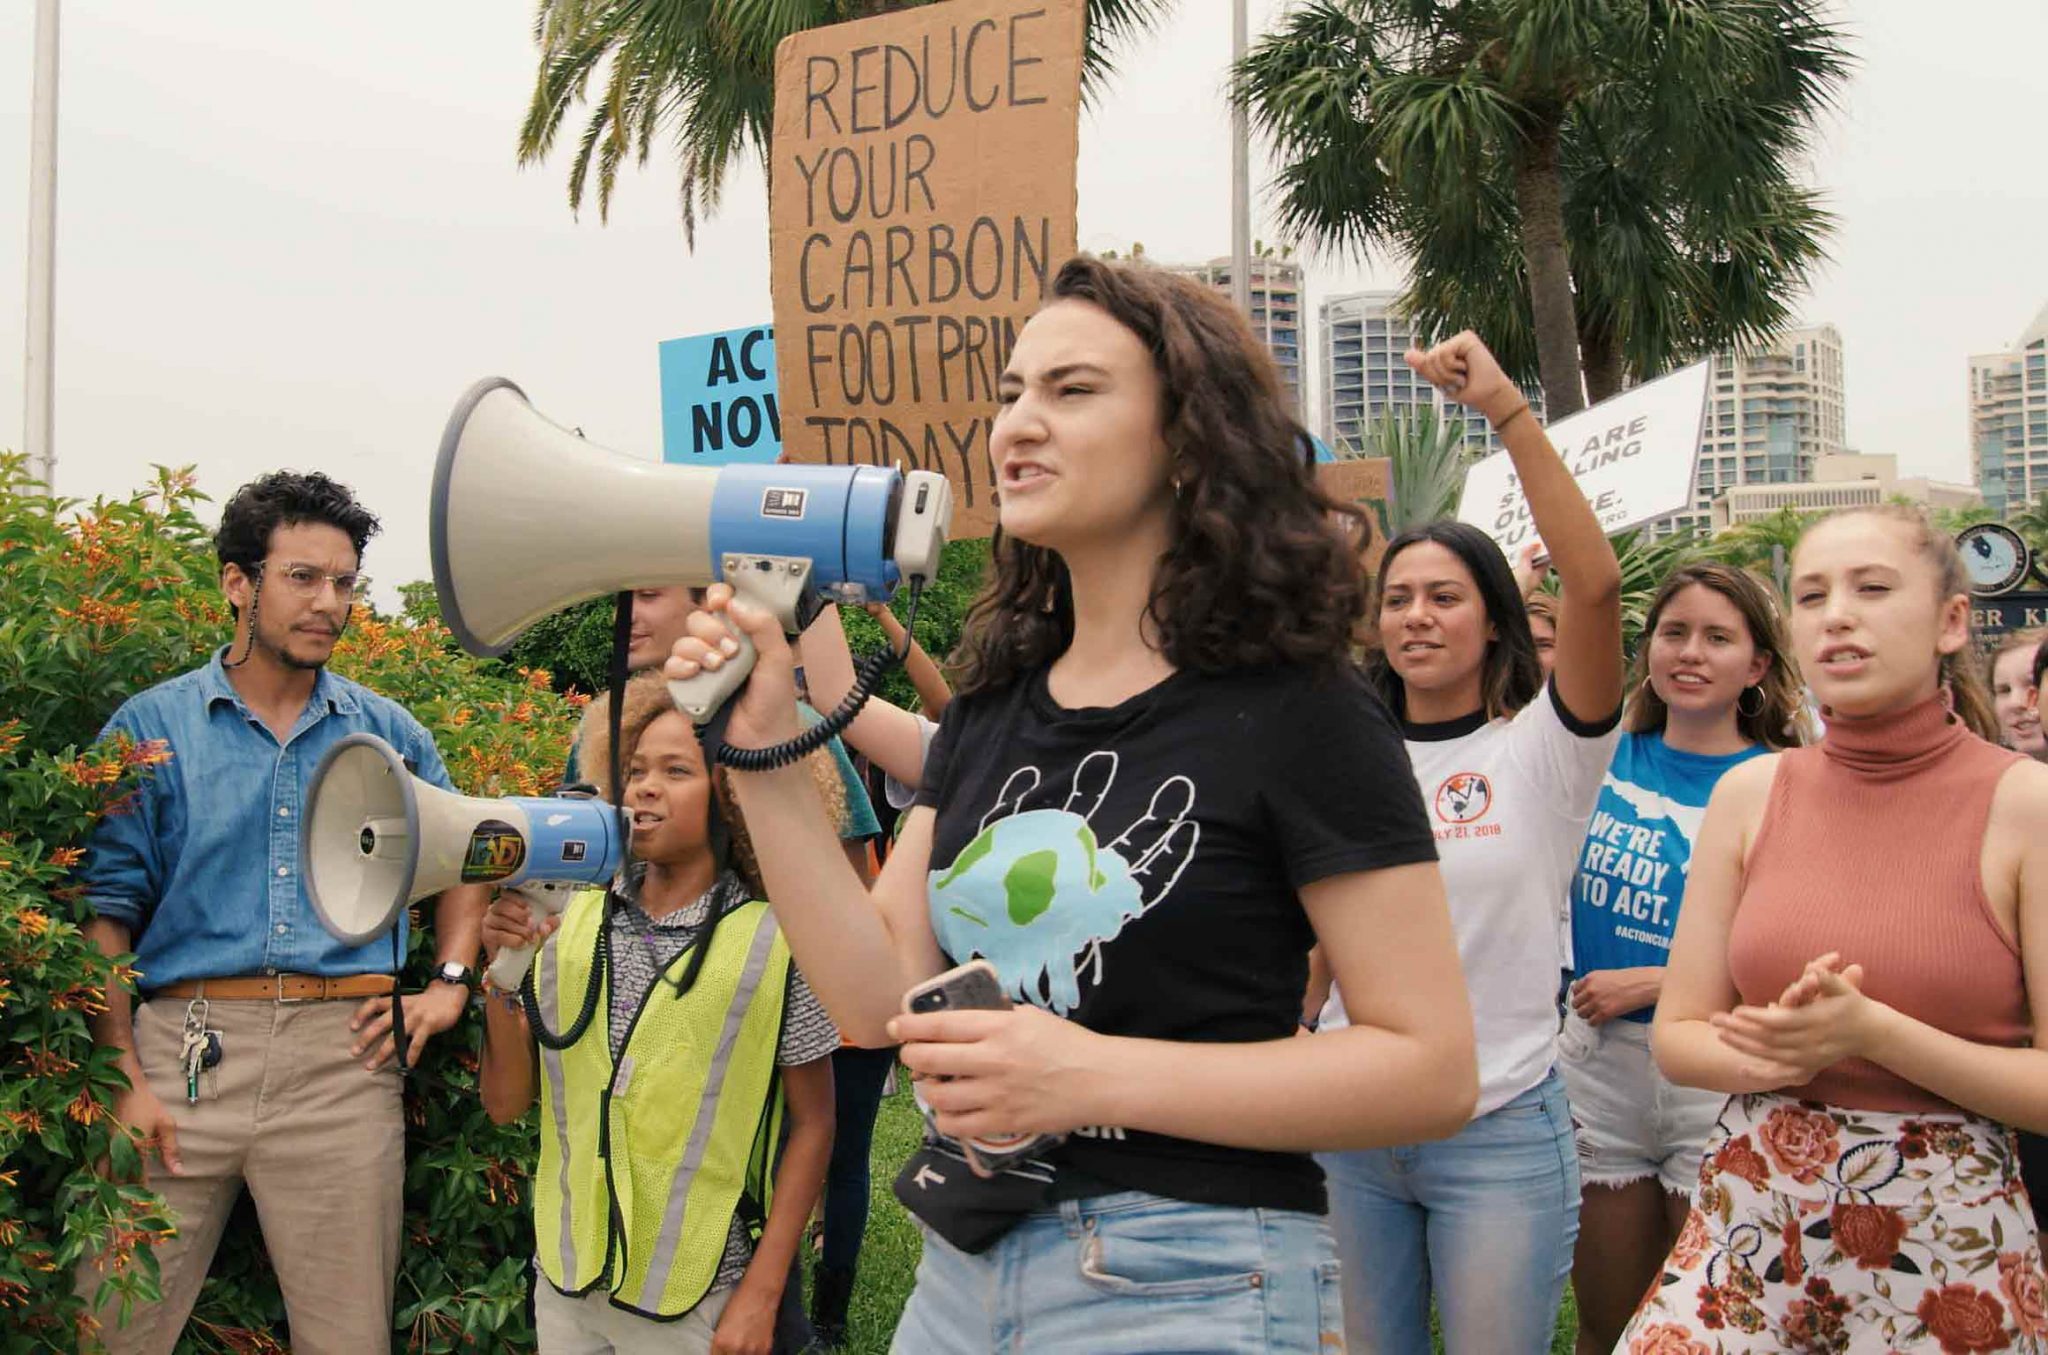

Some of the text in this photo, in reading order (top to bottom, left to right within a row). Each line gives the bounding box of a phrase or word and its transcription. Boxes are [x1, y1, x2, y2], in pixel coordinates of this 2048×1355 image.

[806, 9, 1048, 139] REDUCE
[796, 134, 936, 227] YOUR
[800, 215, 1050, 314] CARBON
[806, 315, 1031, 408] FOOTPRI
[1581, 416, 1648, 458] ARE
[1474, 823, 1502, 837] 2018
[1589, 810, 1666, 858] WE'RE
[1584, 841, 1670, 891] READY
[1581, 873, 1670, 927] TO ACT.
